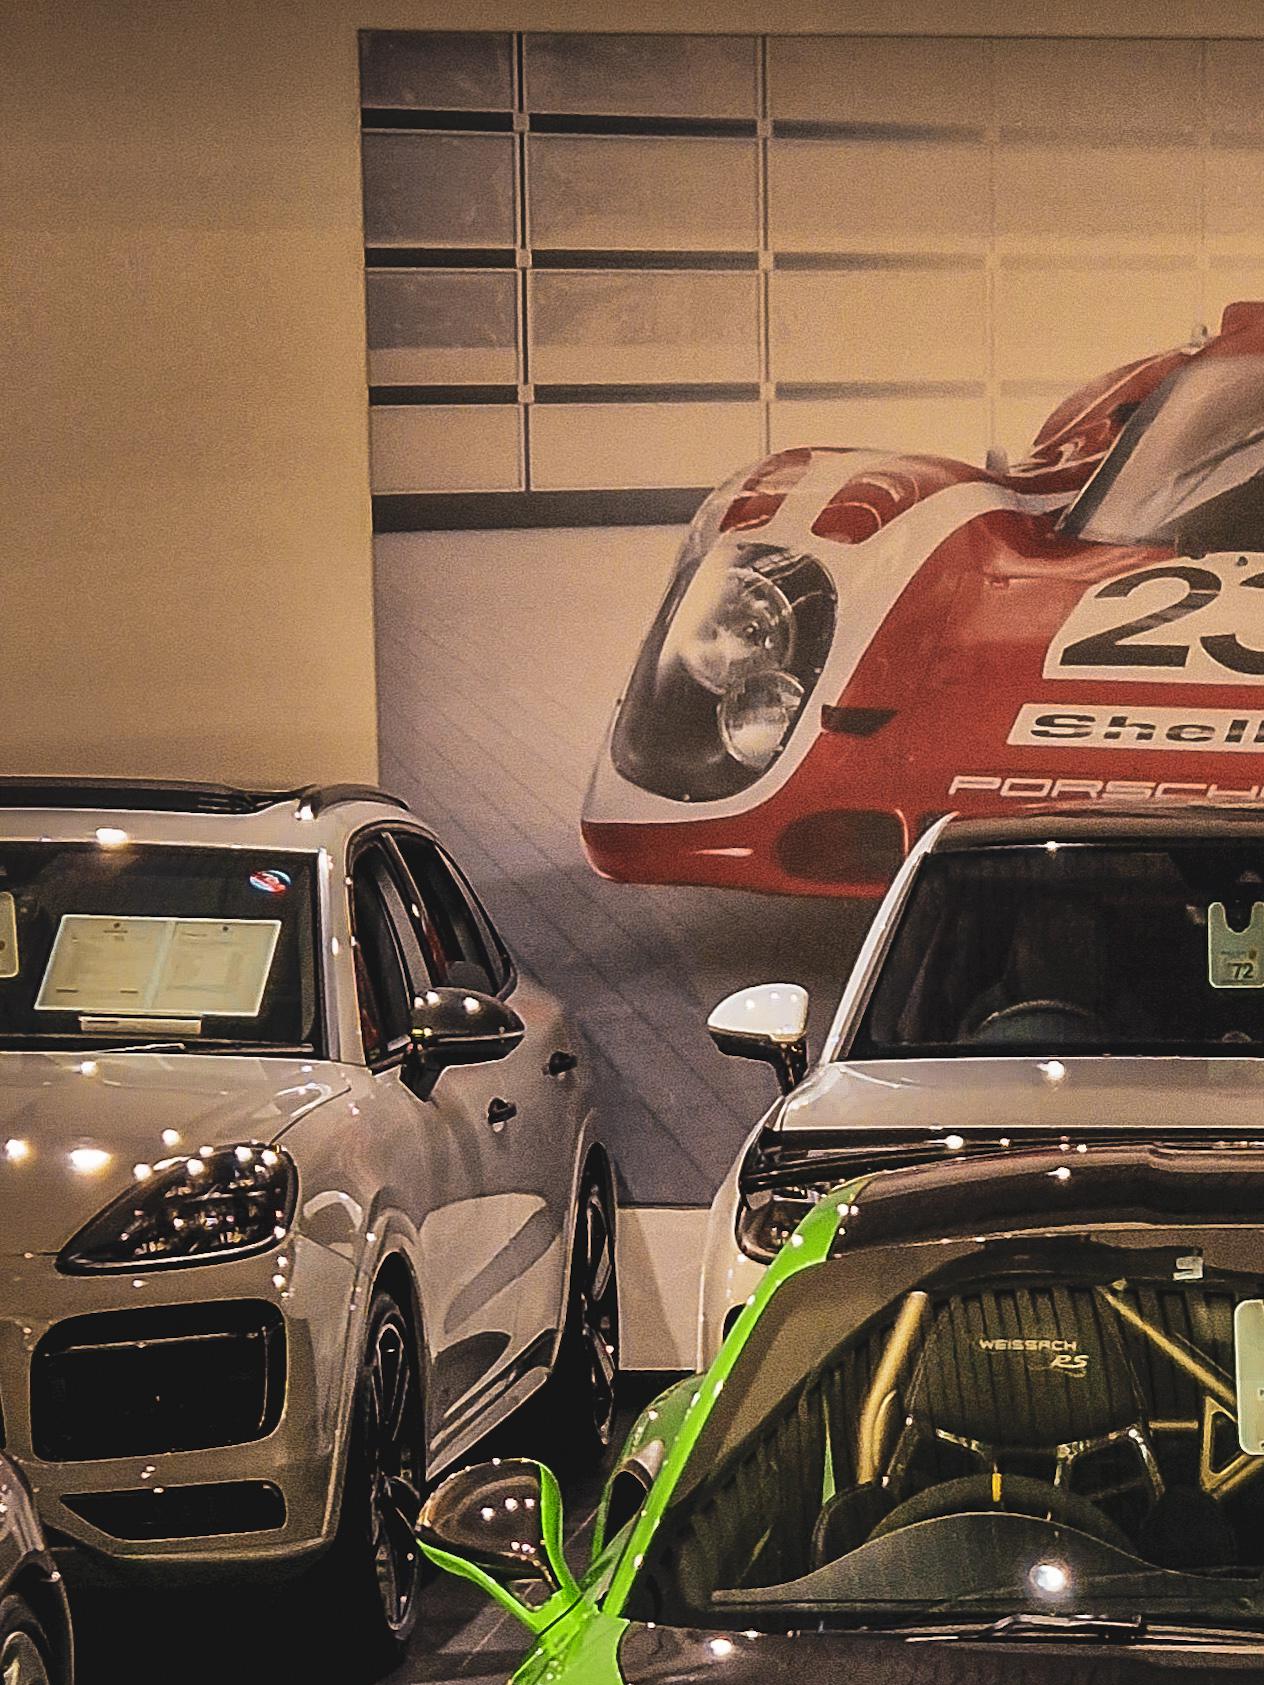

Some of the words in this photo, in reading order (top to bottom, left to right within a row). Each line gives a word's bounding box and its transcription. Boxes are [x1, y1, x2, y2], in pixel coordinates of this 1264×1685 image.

[1230, 962, 1254, 979] 72
[979, 1339, 1077, 1351] WEISSACH
[1050, 1354, 1090, 1369] RS
